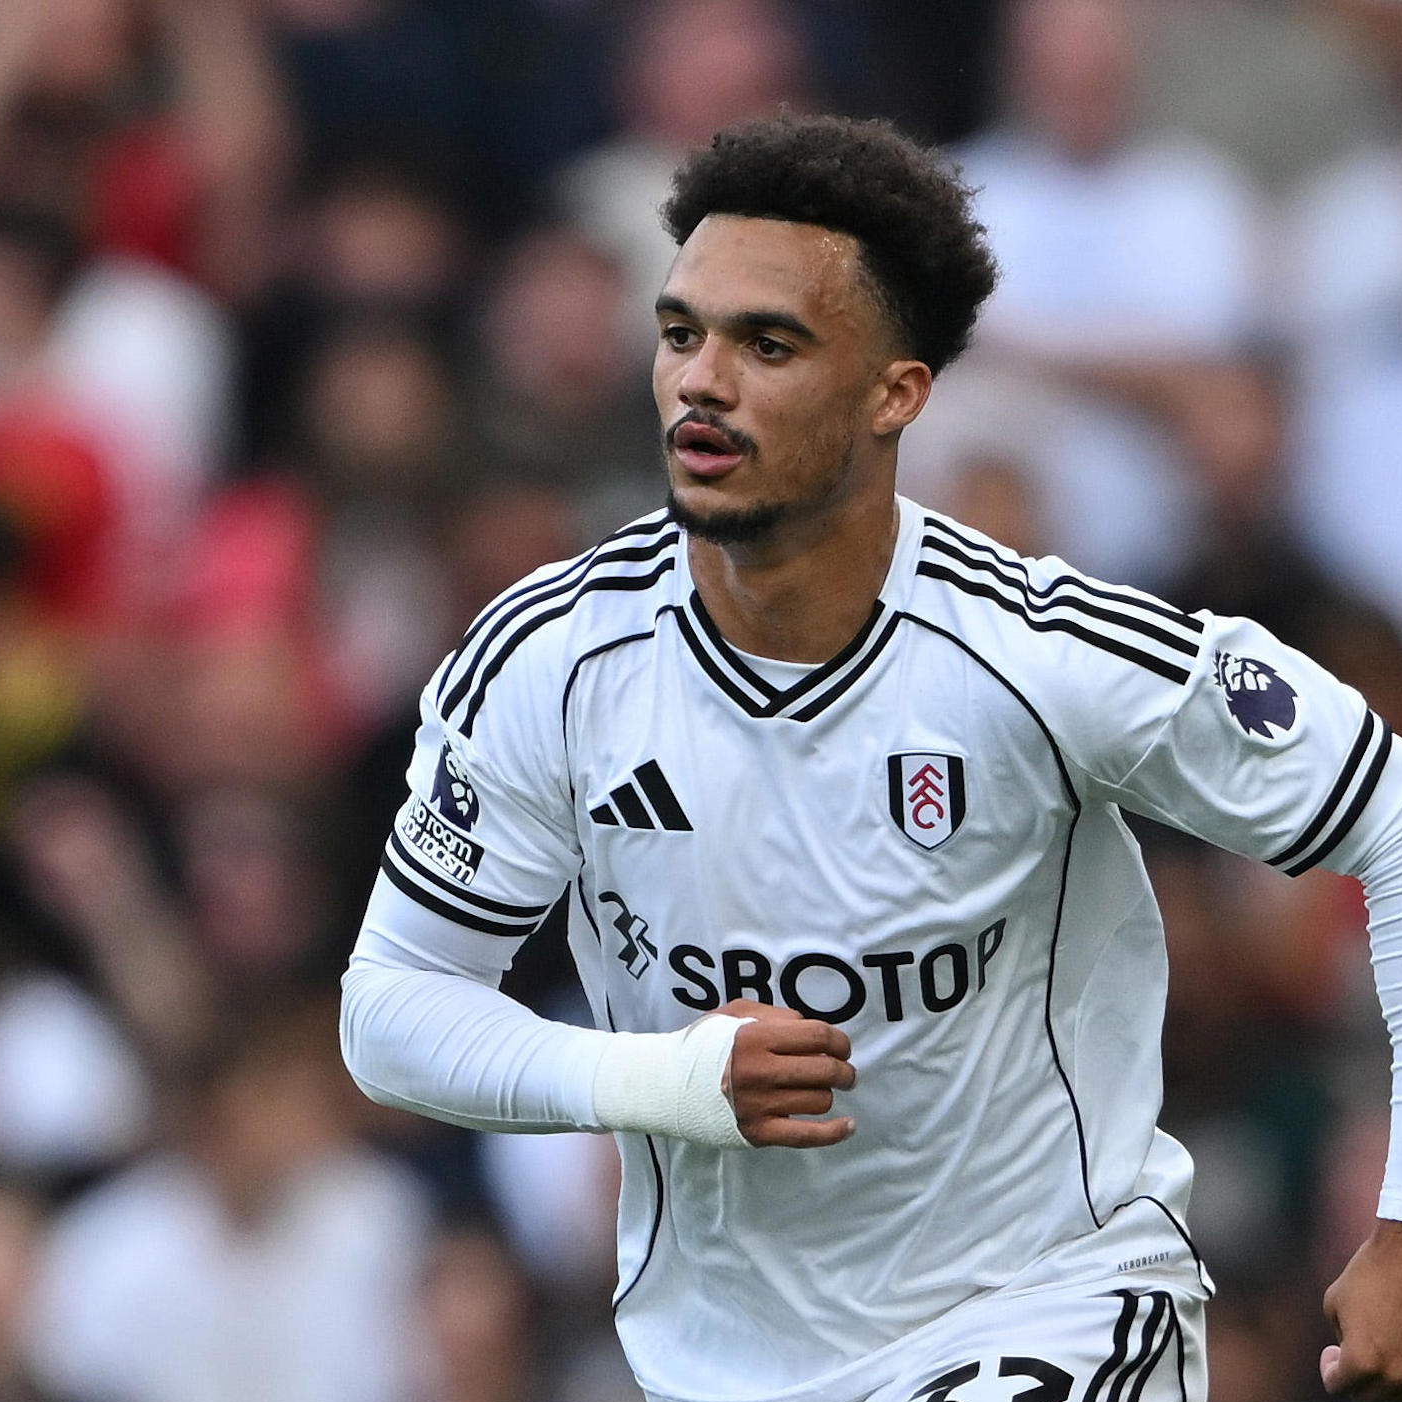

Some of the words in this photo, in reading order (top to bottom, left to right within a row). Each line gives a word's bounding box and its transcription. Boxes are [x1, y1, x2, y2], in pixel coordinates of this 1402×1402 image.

[416, 831, 475, 886] racism
[426, 815, 472, 862] room
[668, 917, 1007, 1023] SBOTOP
[1117, 1251, 1170, 1272] AEROREADY
